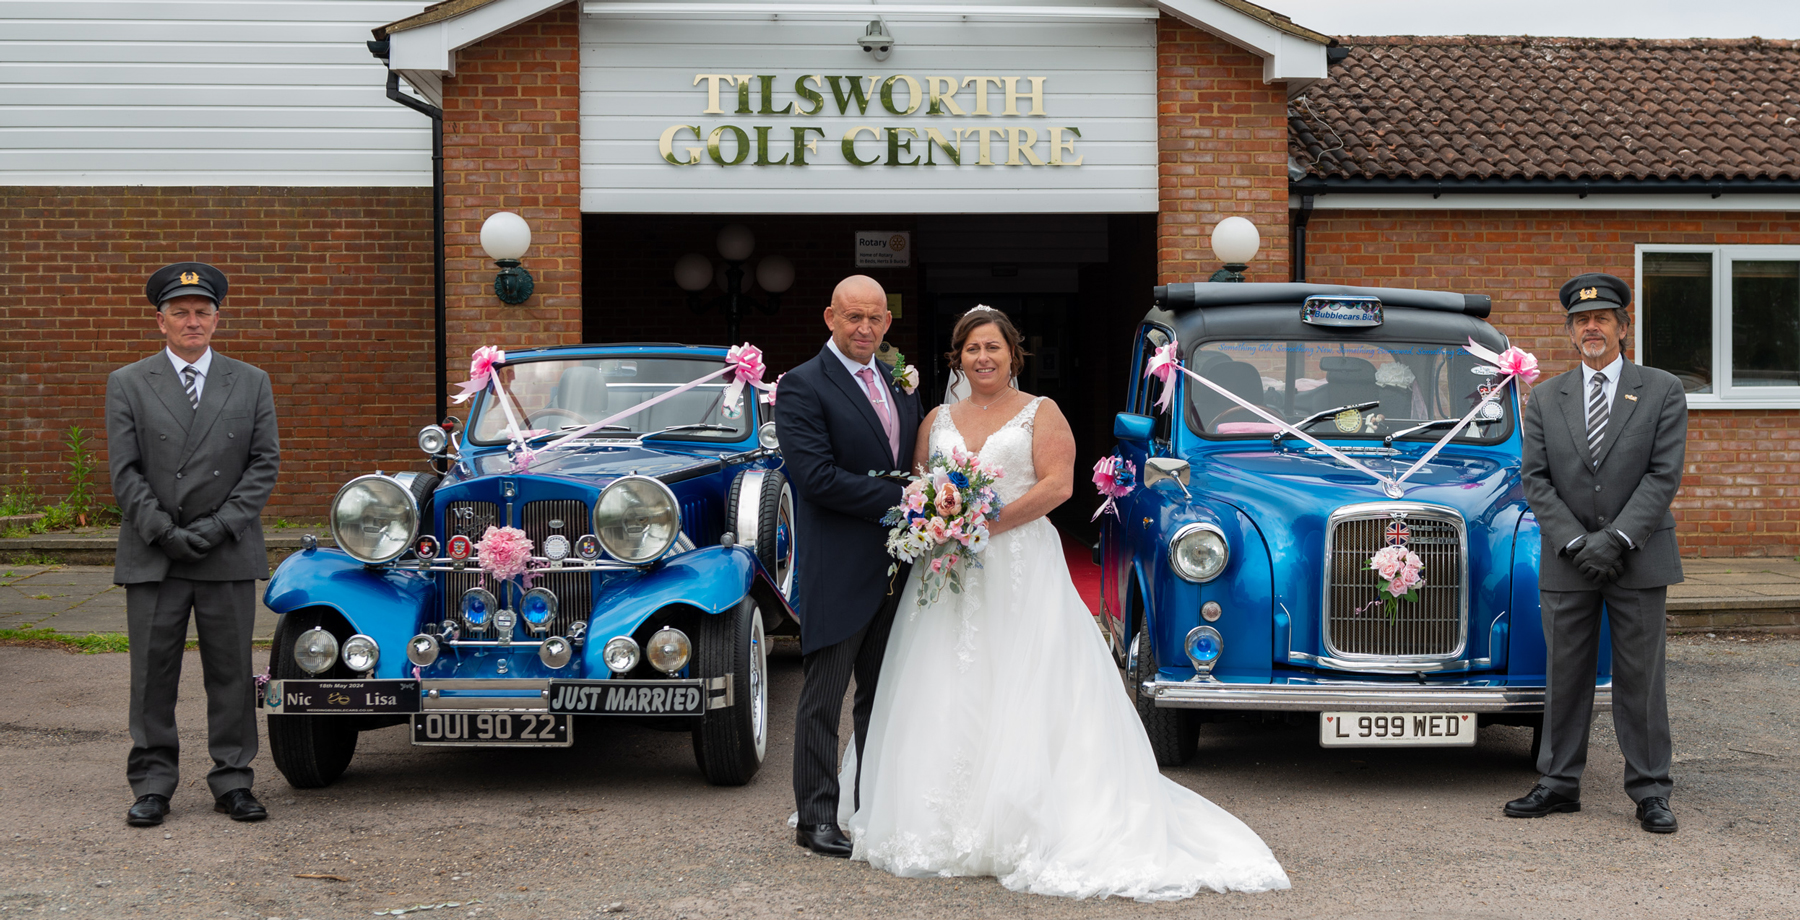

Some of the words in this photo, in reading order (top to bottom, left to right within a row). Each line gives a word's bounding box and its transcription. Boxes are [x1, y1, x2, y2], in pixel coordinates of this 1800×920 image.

[693, 74, 1047, 116] TILSWORTH
[658, 124, 826, 167] GOLF
[841, 125, 1084, 167] CENTRE
[859, 238, 887, 248] Rotary
[1314, 311, 1373, 321] Bubblecars.Biz
[1218, 342, 1257, 355] Something
[1258, 342, 1274, 353] Old,
[1275, 344, 1314, 357] Something
[1316, 345, 1334, 354] New,
[1336, 345, 1375, 358] Something
[1377, 346, 1414, 356] Borrowed,
[1416, 346, 1454, 359] Something
[452, 506, 474, 519] V8
[287, 692, 312, 706] Nic
[365, 692, 397, 706] Lisa
[552, 686, 602, 711] JUST
[605, 687, 700, 713] MARRIED
[426, 714, 469, 739] OUI
[476, 714, 512, 739] 90
[520, 714, 556, 739] 22
[1336, 716, 1350, 738] L
[1358, 716, 1405, 738] 999
[1413, 715, 1460, 737] WED
